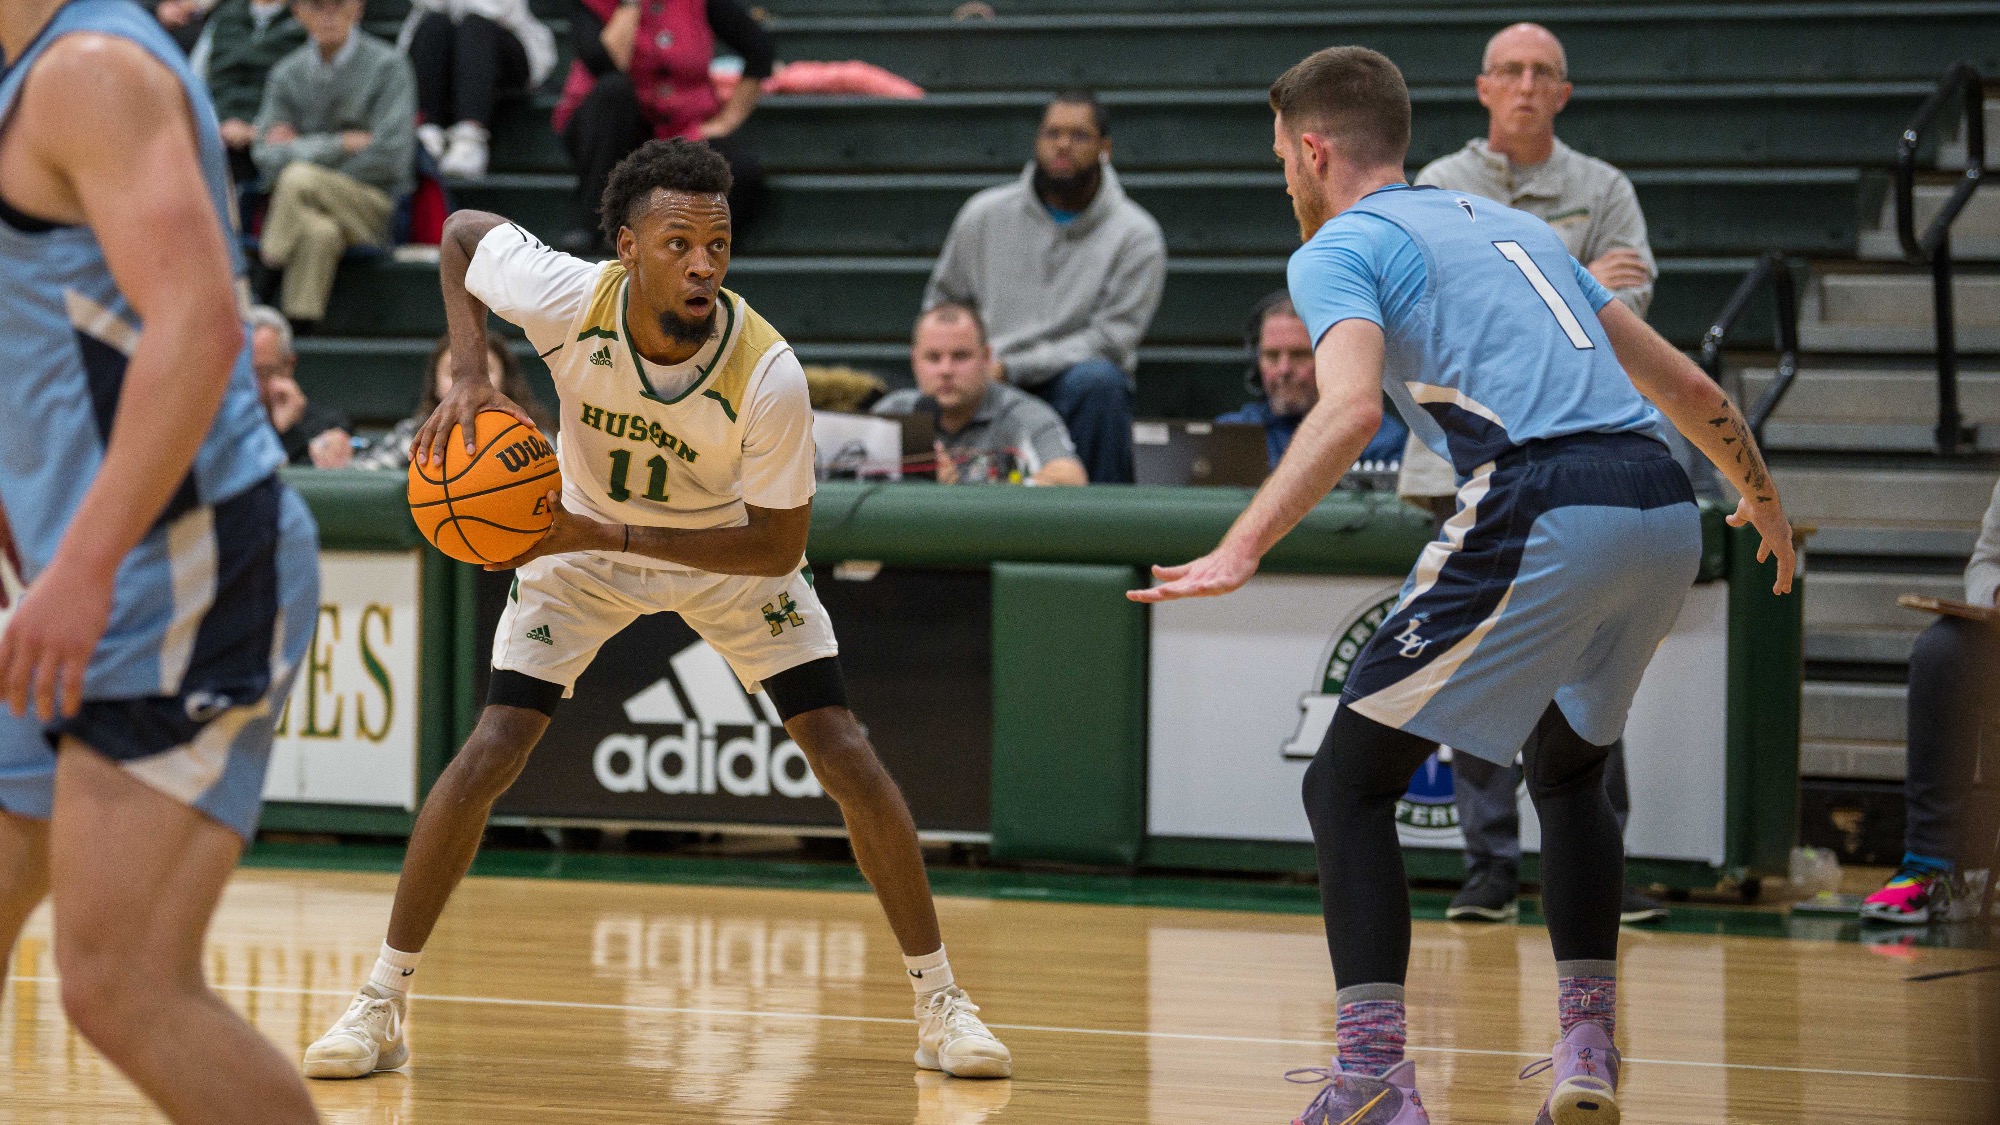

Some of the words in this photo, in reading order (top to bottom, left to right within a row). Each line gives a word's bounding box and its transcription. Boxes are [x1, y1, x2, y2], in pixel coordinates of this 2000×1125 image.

[1491, 239, 1596, 350] 1
[607, 448, 670, 503] 11
[275, 604, 394, 743] ES
[526, 632, 554, 646] adidas
[1327, 600, 1397, 683] NORT
[593, 719, 826, 798] adida
